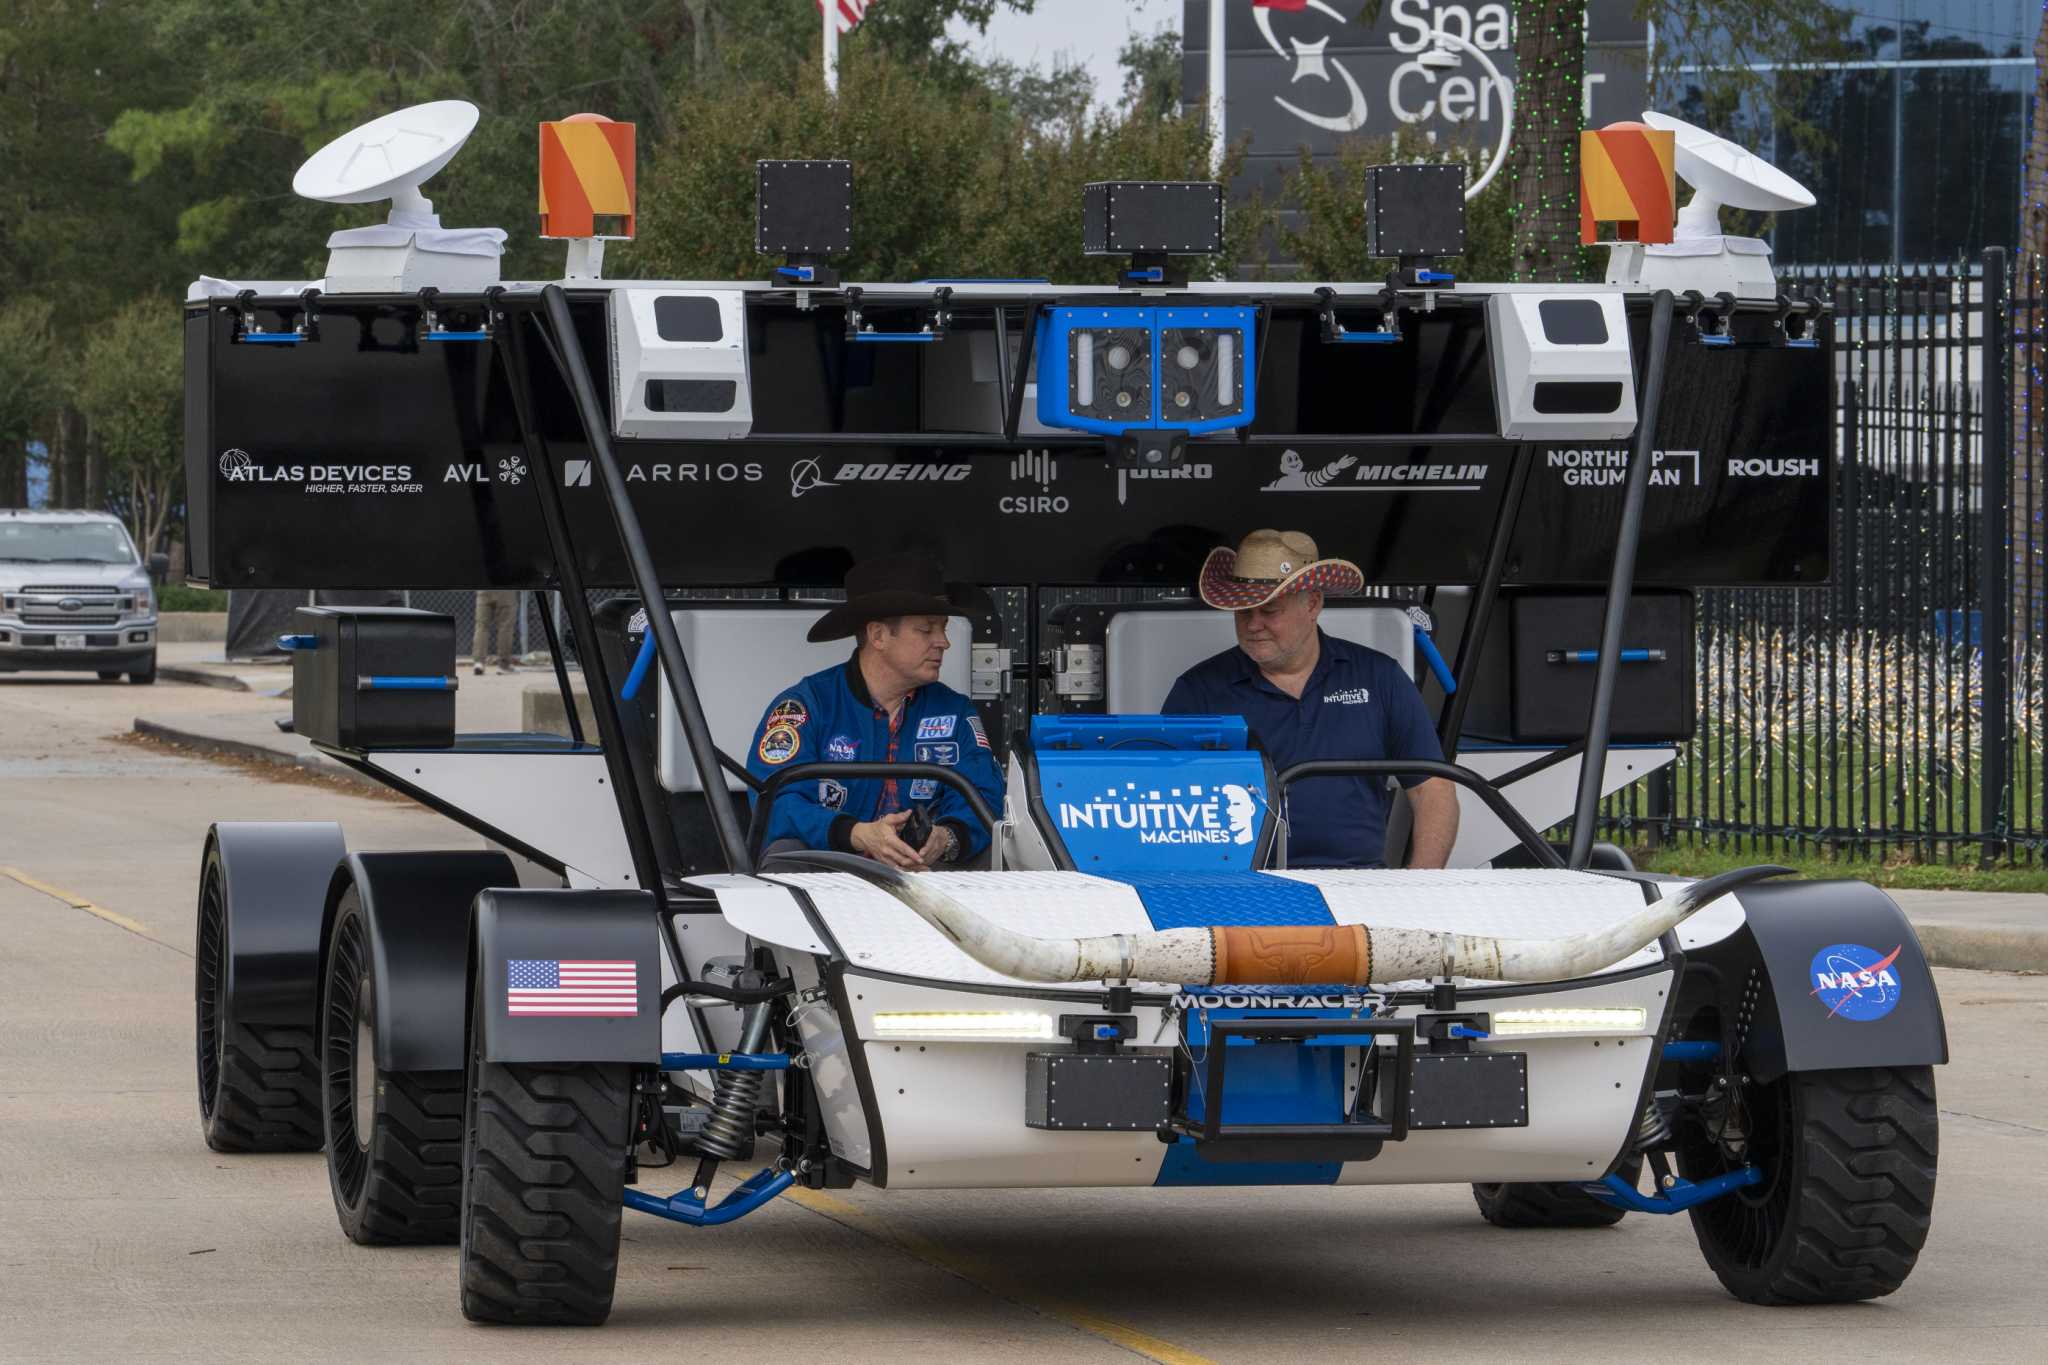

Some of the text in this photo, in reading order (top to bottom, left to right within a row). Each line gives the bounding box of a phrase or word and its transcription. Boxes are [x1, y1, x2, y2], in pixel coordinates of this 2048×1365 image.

[1389, 0, 1589, 53] Spa
[1389, 61, 1606, 123] Cenr
[1547, 450, 1665, 467] NORTHP
[1728, 458, 1819, 477] ROUSH
[229, 465, 412, 482] ATLAS DEVICES
[443, 463, 490, 483] AVL
[626, 463, 763, 482] ARRIOS
[833, 463, 972, 481] BOEING
[1355, 463, 1489, 481] MICHELIN
[1563, 468, 1681, 486] GRUMAN
[305, 484, 423, 494] HIGHER, FASTER, SAFER
[999, 496, 1070, 514] CSIRO
[828, 743, 856, 756] NASA
[1060, 800, 1221, 829] INTUITIVE
[1140, 828, 1230, 844] MACHINES
[1816, 969, 1897, 990] NASA
[1170, 994, 1387, 1010] MOONRACER
